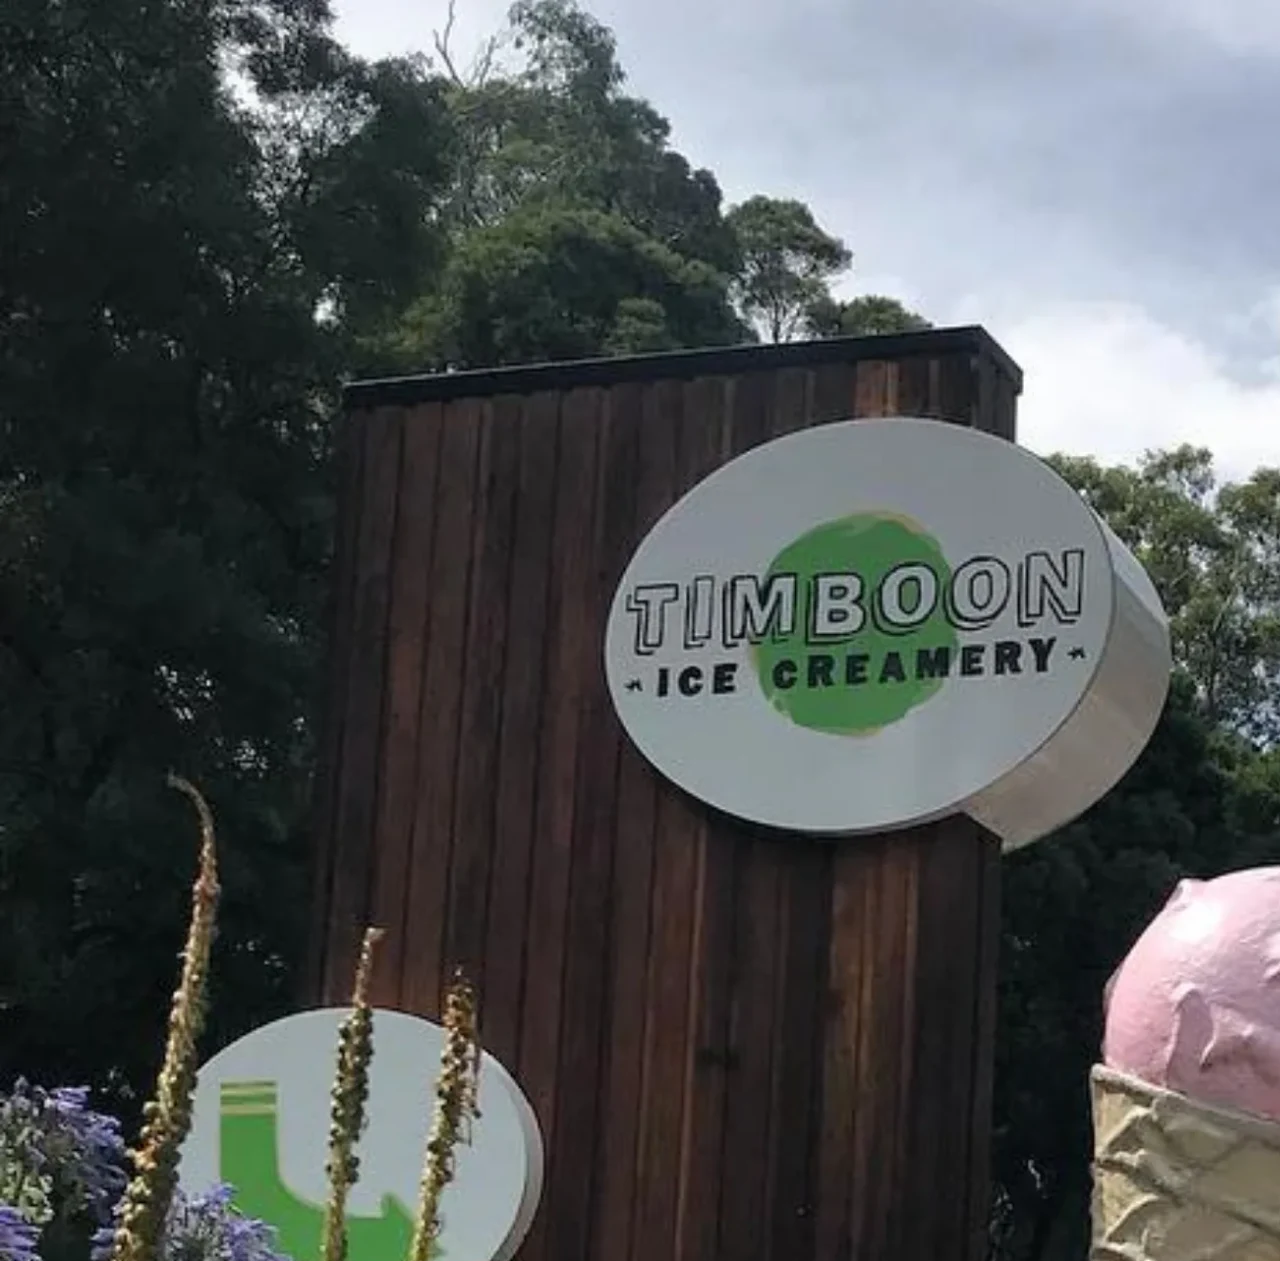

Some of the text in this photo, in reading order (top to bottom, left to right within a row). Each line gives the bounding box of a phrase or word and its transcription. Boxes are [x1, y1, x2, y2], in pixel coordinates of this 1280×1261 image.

[626, 549, 1085, 655] TIMBOON
[657, 638, 1057, 697] ICE CREAMERY
